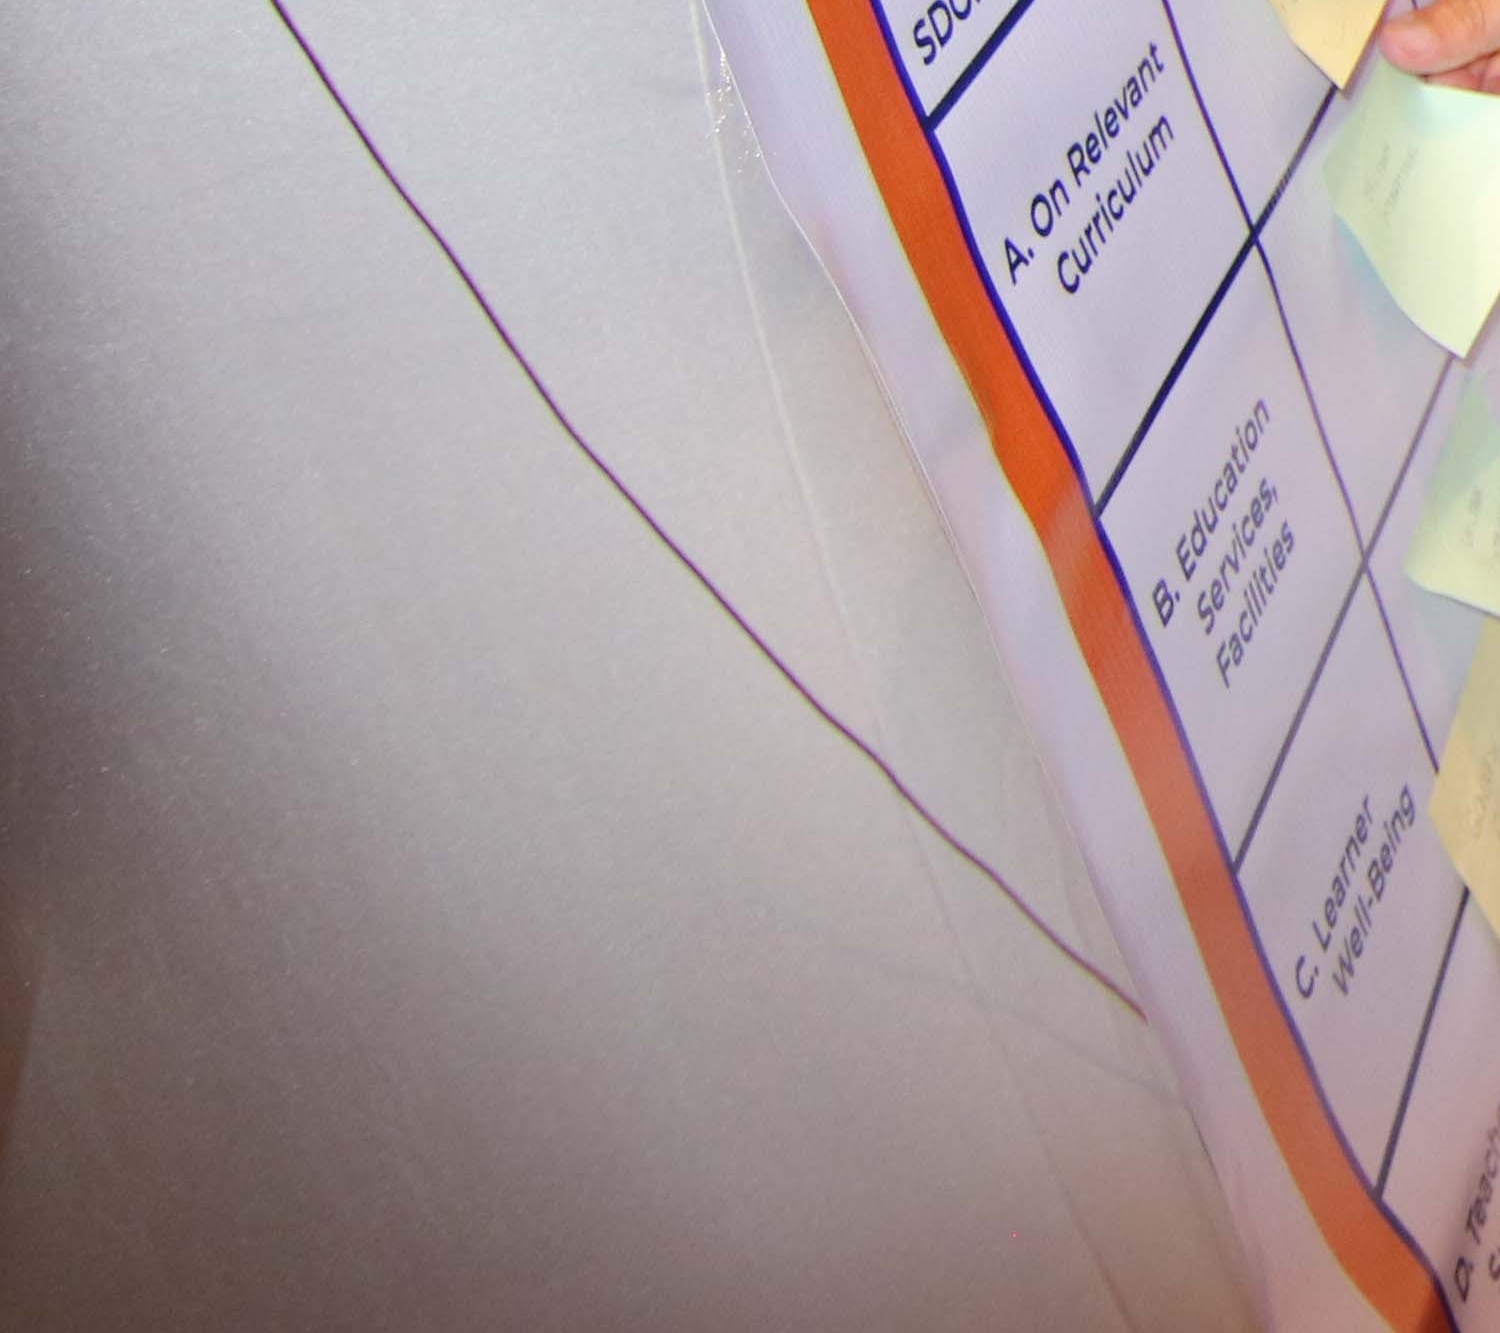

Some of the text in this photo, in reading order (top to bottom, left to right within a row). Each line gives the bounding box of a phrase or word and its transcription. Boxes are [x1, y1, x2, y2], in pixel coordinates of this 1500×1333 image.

[1002, 42, 1166, 286] A. On Relevant
[1056, 114, 1175, 295] Curriculum
[1152, 397, 1272, 630] B. Education
[1196, 481, 1280, 636] Services,
[1216, 524, 1297, 690] Facilities
[1295, 793, 1376, 1002] C. Learner
[1332, 782, 1417, 998] Well-Being
